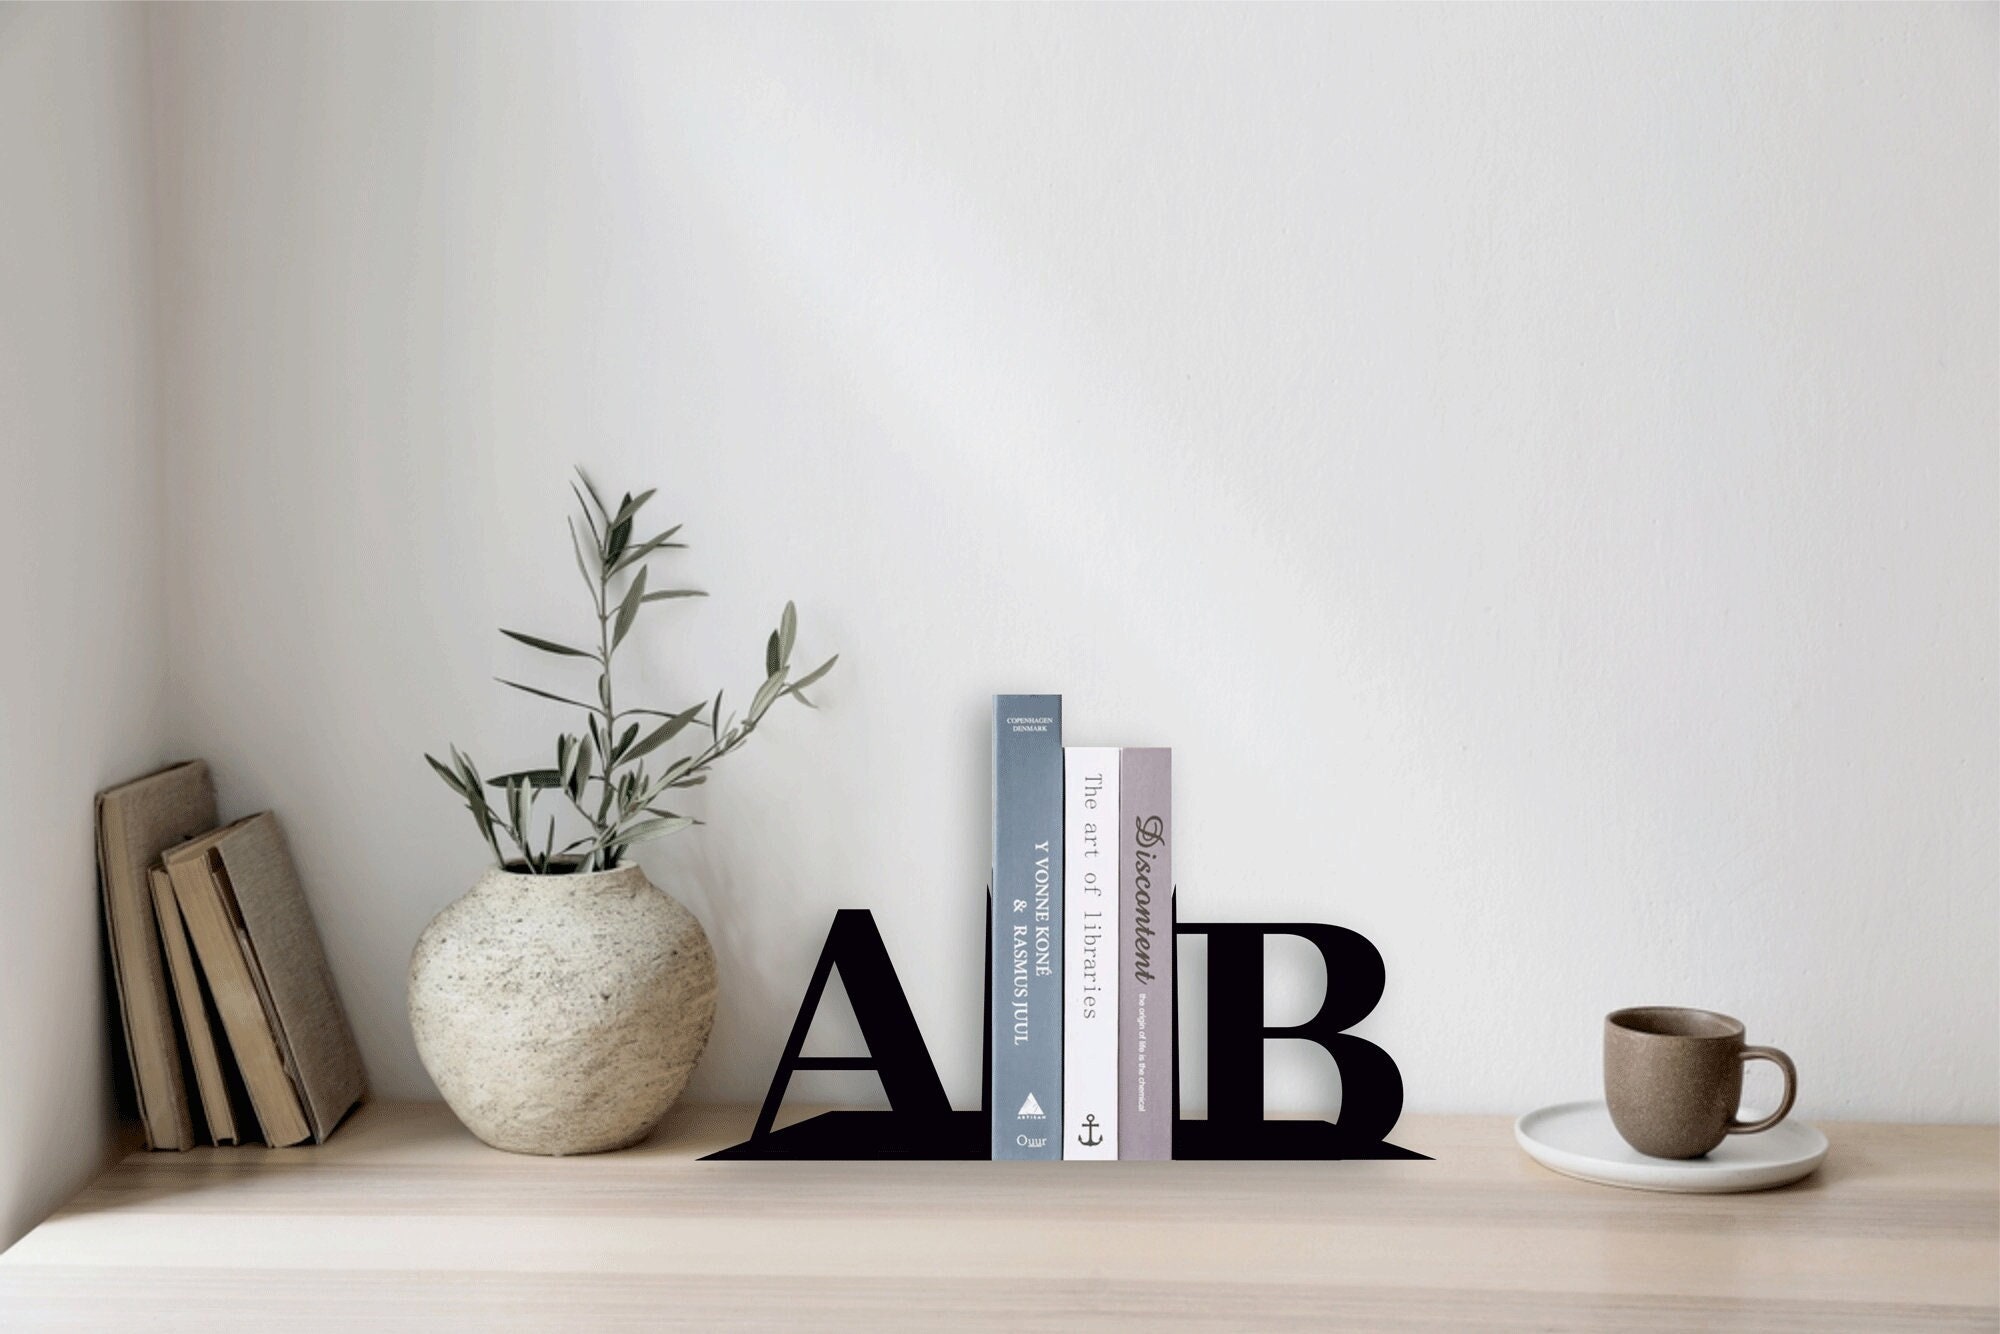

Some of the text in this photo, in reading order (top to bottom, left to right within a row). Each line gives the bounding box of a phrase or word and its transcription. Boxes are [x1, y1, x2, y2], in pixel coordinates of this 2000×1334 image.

[1084, 773, 1103, 1019] The art of libraries
[1134, 815, 1166, 985] Discontent
[1011, 899, 1029, 1046] & RASMUS JUUL
[1034, 926, 1053, 977] KONÉ
[1136, 1007, 1147, 1030] origin
[1138, 993, 1147, 1006] the
[747, 908, 965, 1143] A
[1138, 1031, 1147, 1039] of
[1138, 1041, 1147, 1053] life
[1176, 922, 1405, 1146] B
[1138, 1063, 1147, 1076] the
[1137, 1077, 1147, 1112] chemical
